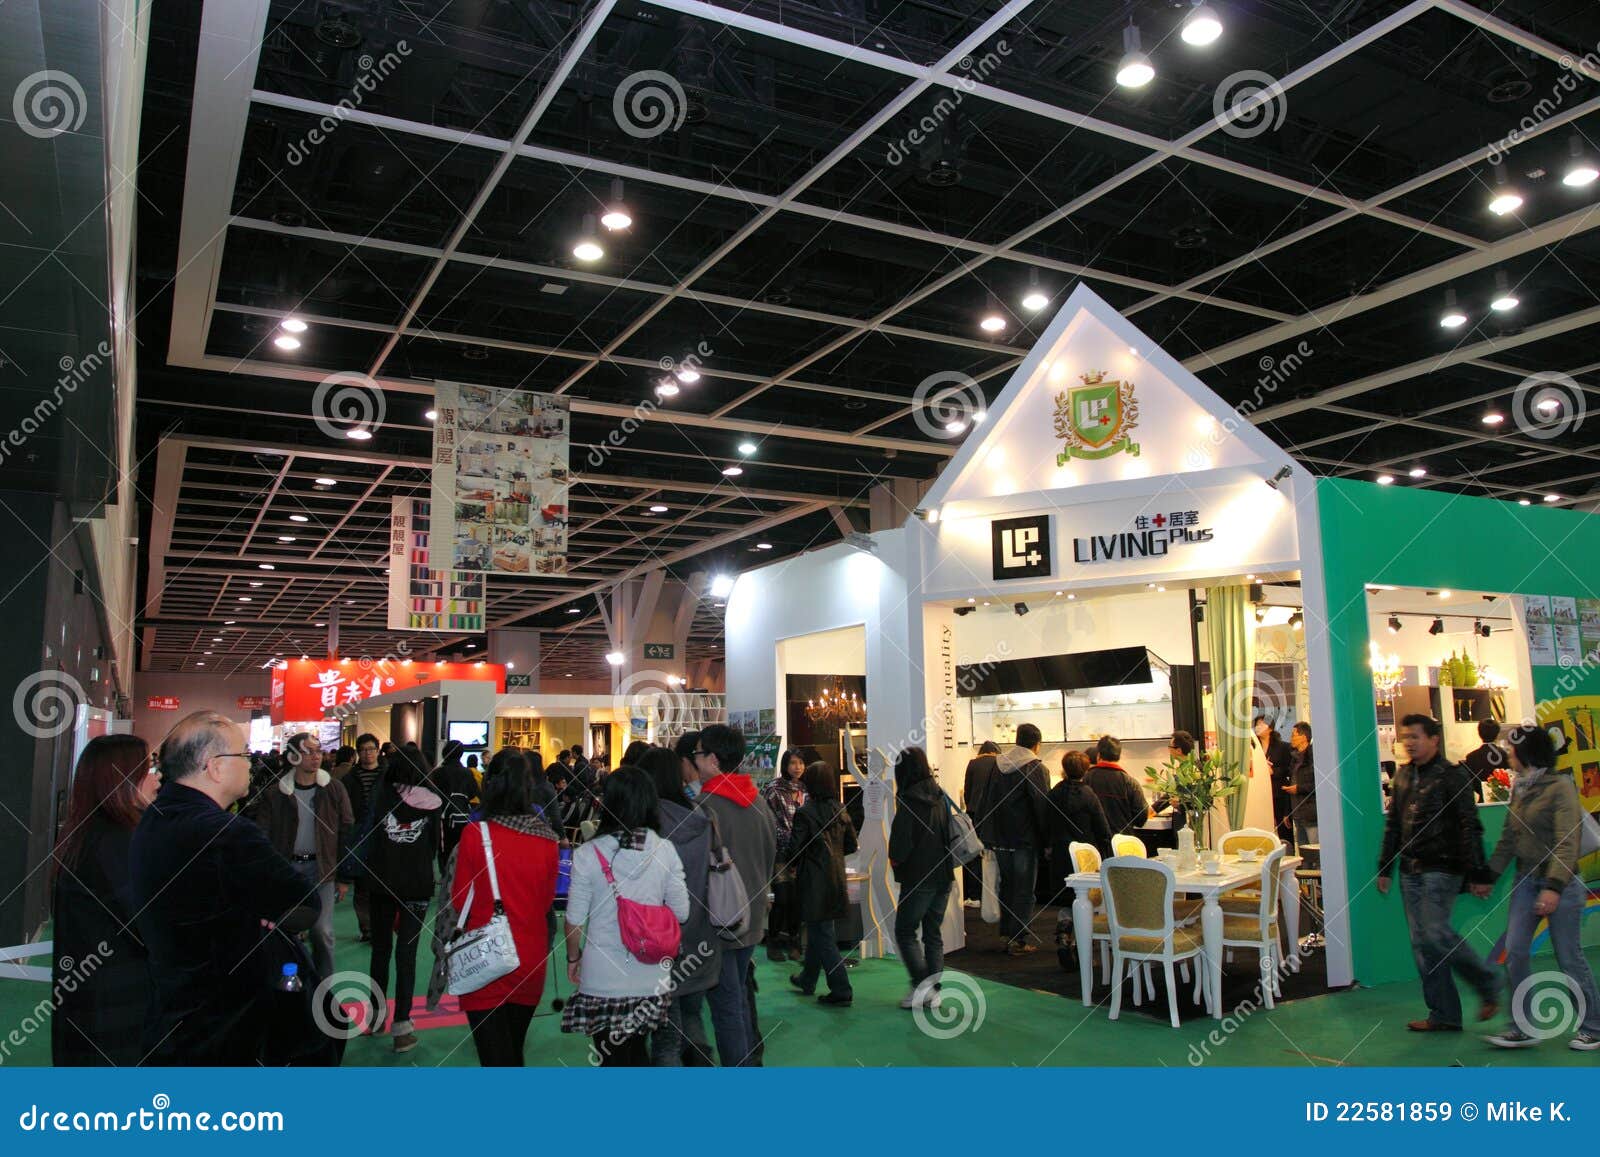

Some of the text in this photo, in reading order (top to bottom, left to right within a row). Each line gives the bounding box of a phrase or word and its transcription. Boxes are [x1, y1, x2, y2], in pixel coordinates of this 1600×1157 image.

[1073, 528, 1214, 563] LIVING Plus
[942, 624, 954, 749] High quality
[459, 933, 508, 969] JACKPO
